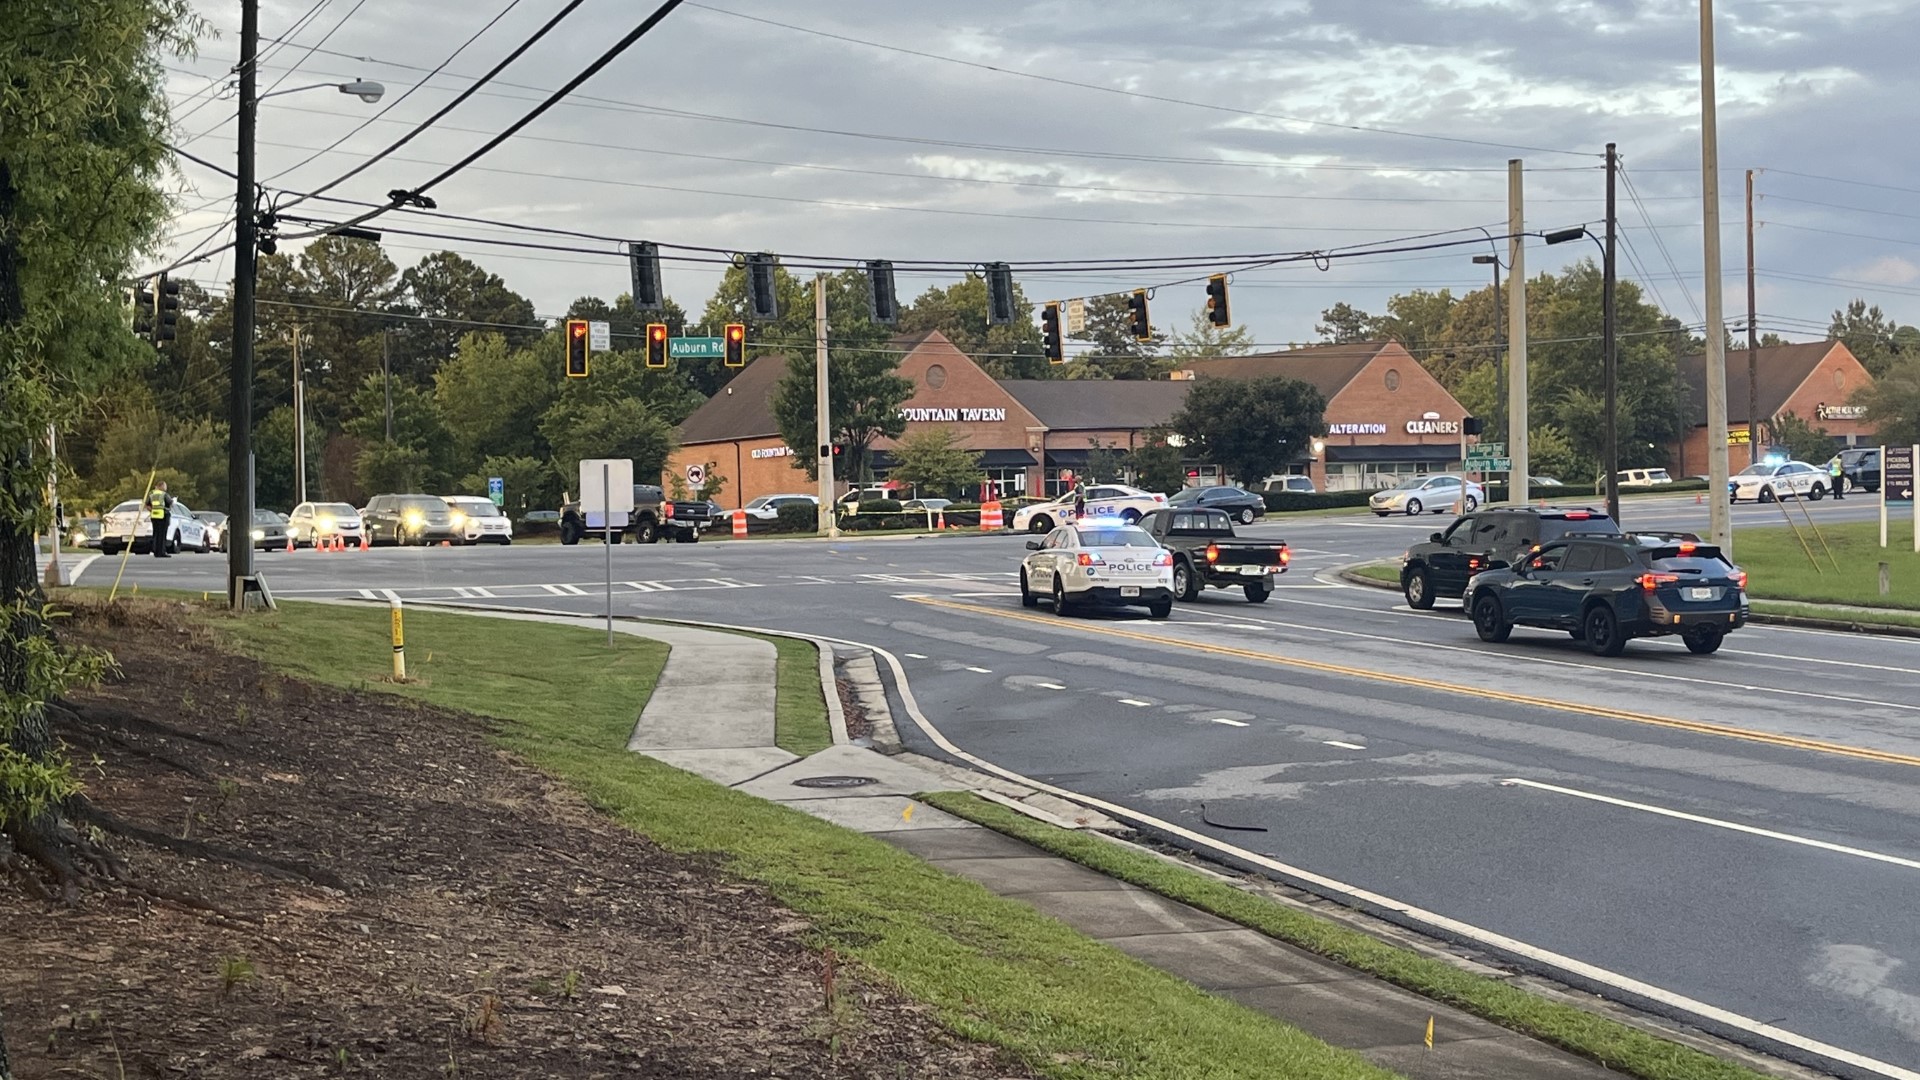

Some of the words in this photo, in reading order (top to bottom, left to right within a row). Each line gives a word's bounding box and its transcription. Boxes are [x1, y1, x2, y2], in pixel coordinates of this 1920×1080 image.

[671, 342, 707, 353] Auburn
[712, 341, 724, 353] Rd
[960, 408, 1006, 421] TAVERN
[1329, 423, 1386, 434] ALTERATION
[1406, 421, 1459, 434] CLEANERS
[1465, 459, 1490, 468] Auburn
[1068, 506, 1115, 517] PLICE
[1108, 563, 1152, 571] POLICE
